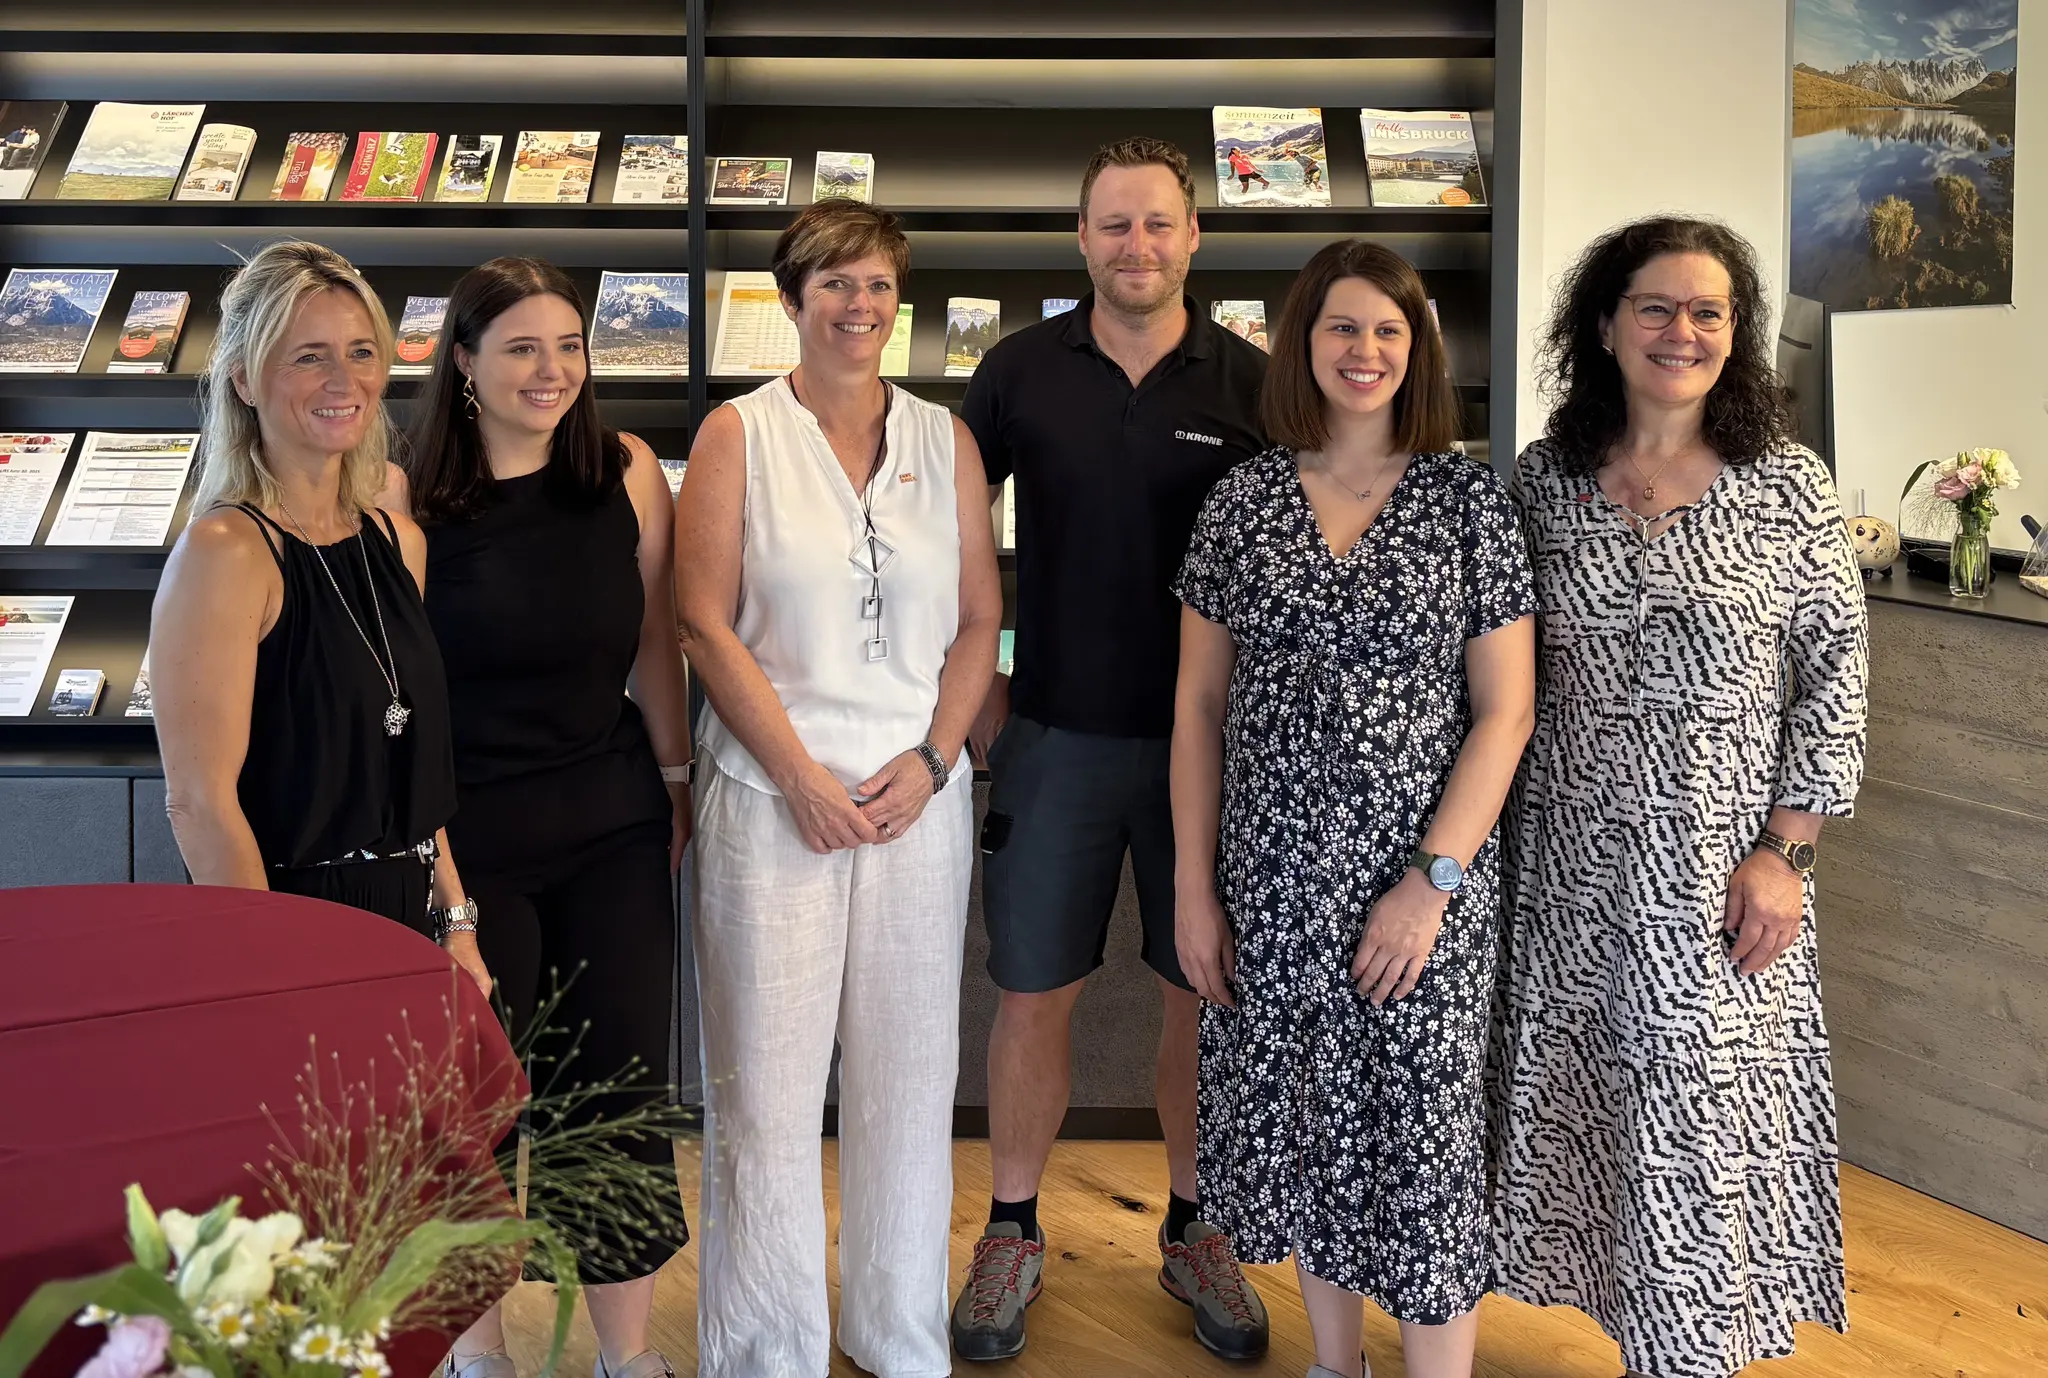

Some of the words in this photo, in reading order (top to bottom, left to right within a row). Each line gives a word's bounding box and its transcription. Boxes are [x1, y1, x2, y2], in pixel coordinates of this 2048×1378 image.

[1225, 110, 1295, 120] sonnenzeit
[1369, 128, 1469, 140] INNSBRUCK
[360, 137, 377, 176] SCHWARZ
[12, 273, 110, 284] PASSEGGIATA
[135, 292, 184, 300] WELCOME
[1186, 432, 1223, 446] KRONE
